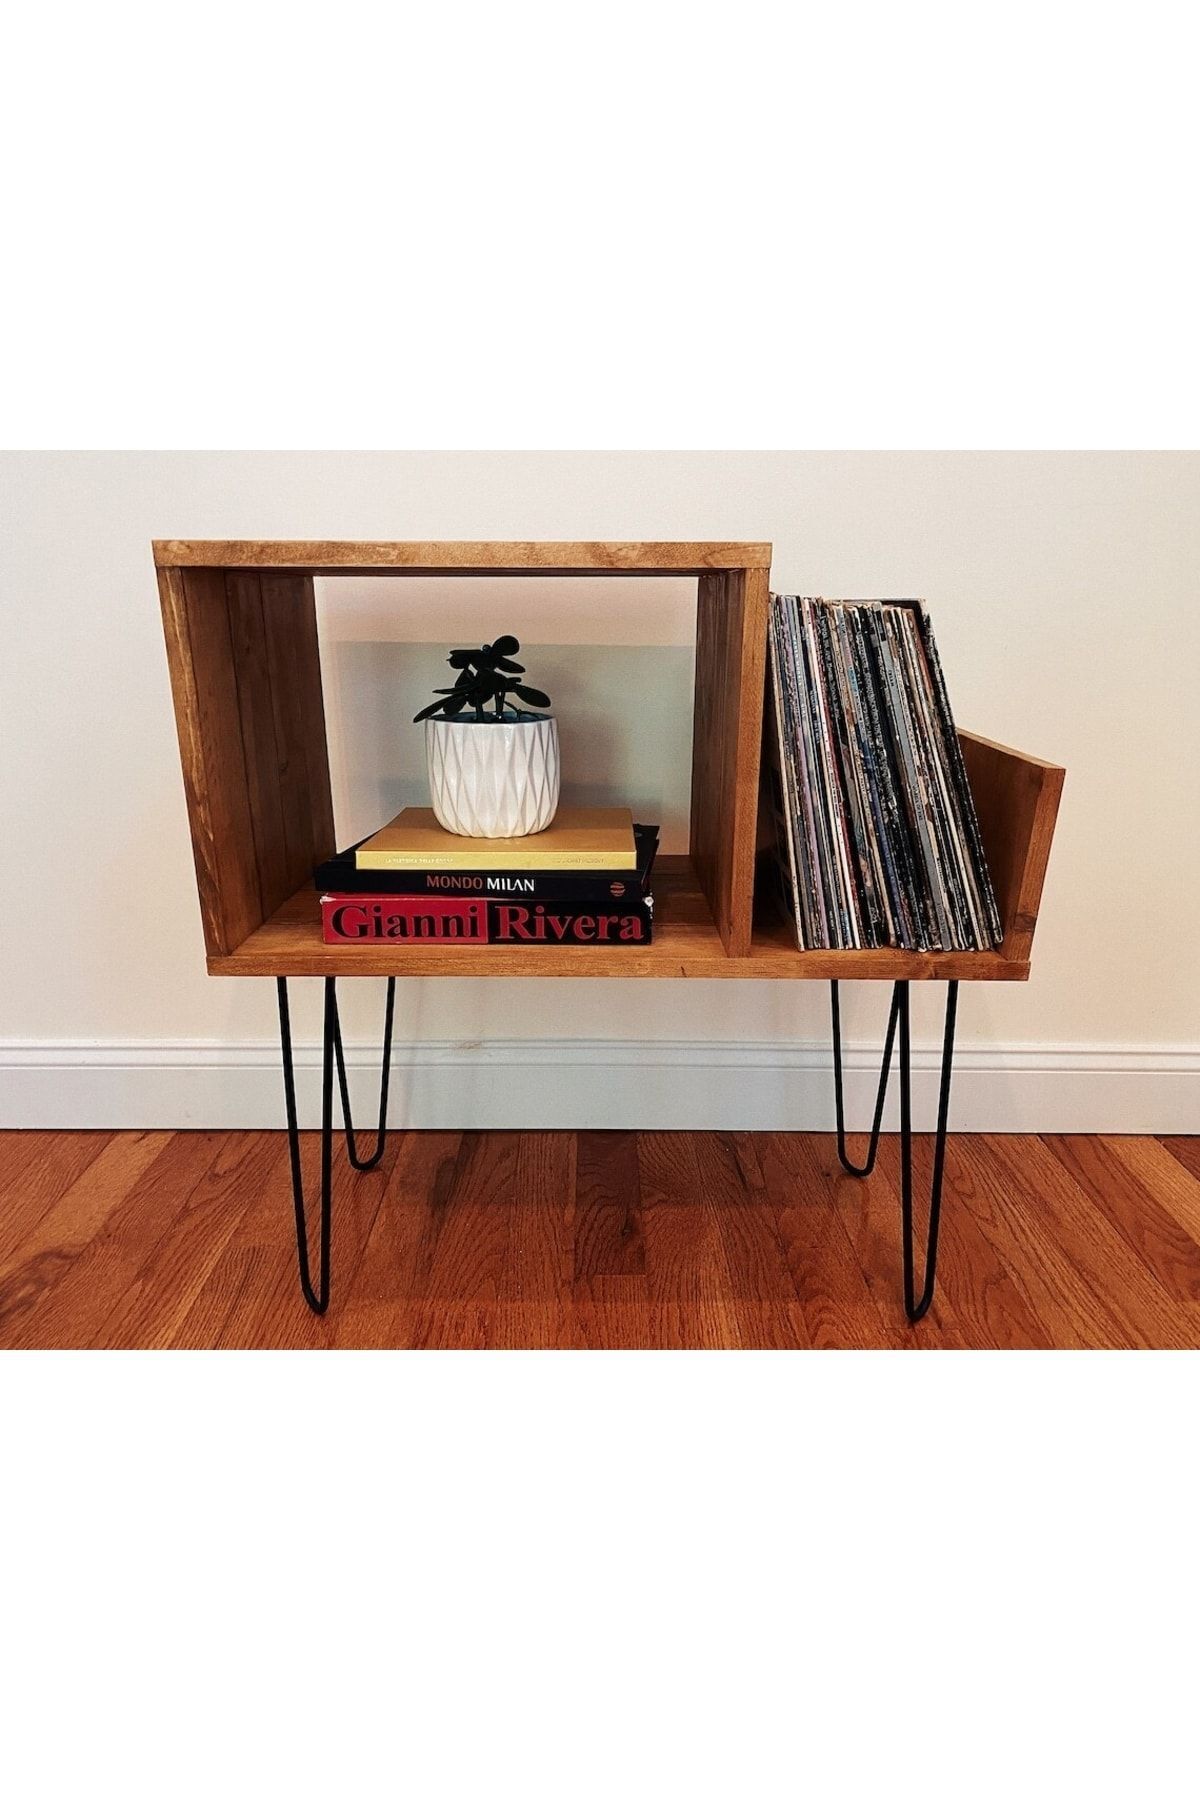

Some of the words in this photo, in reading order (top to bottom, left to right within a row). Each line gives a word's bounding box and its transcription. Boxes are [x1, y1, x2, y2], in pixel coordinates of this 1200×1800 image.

[426, 875, 483, 890] MONDO
[486, 877, 535, 893] MILAN
[331, 905, 480, 938] Gianni
[494, 905, 644, 940] Rivera
